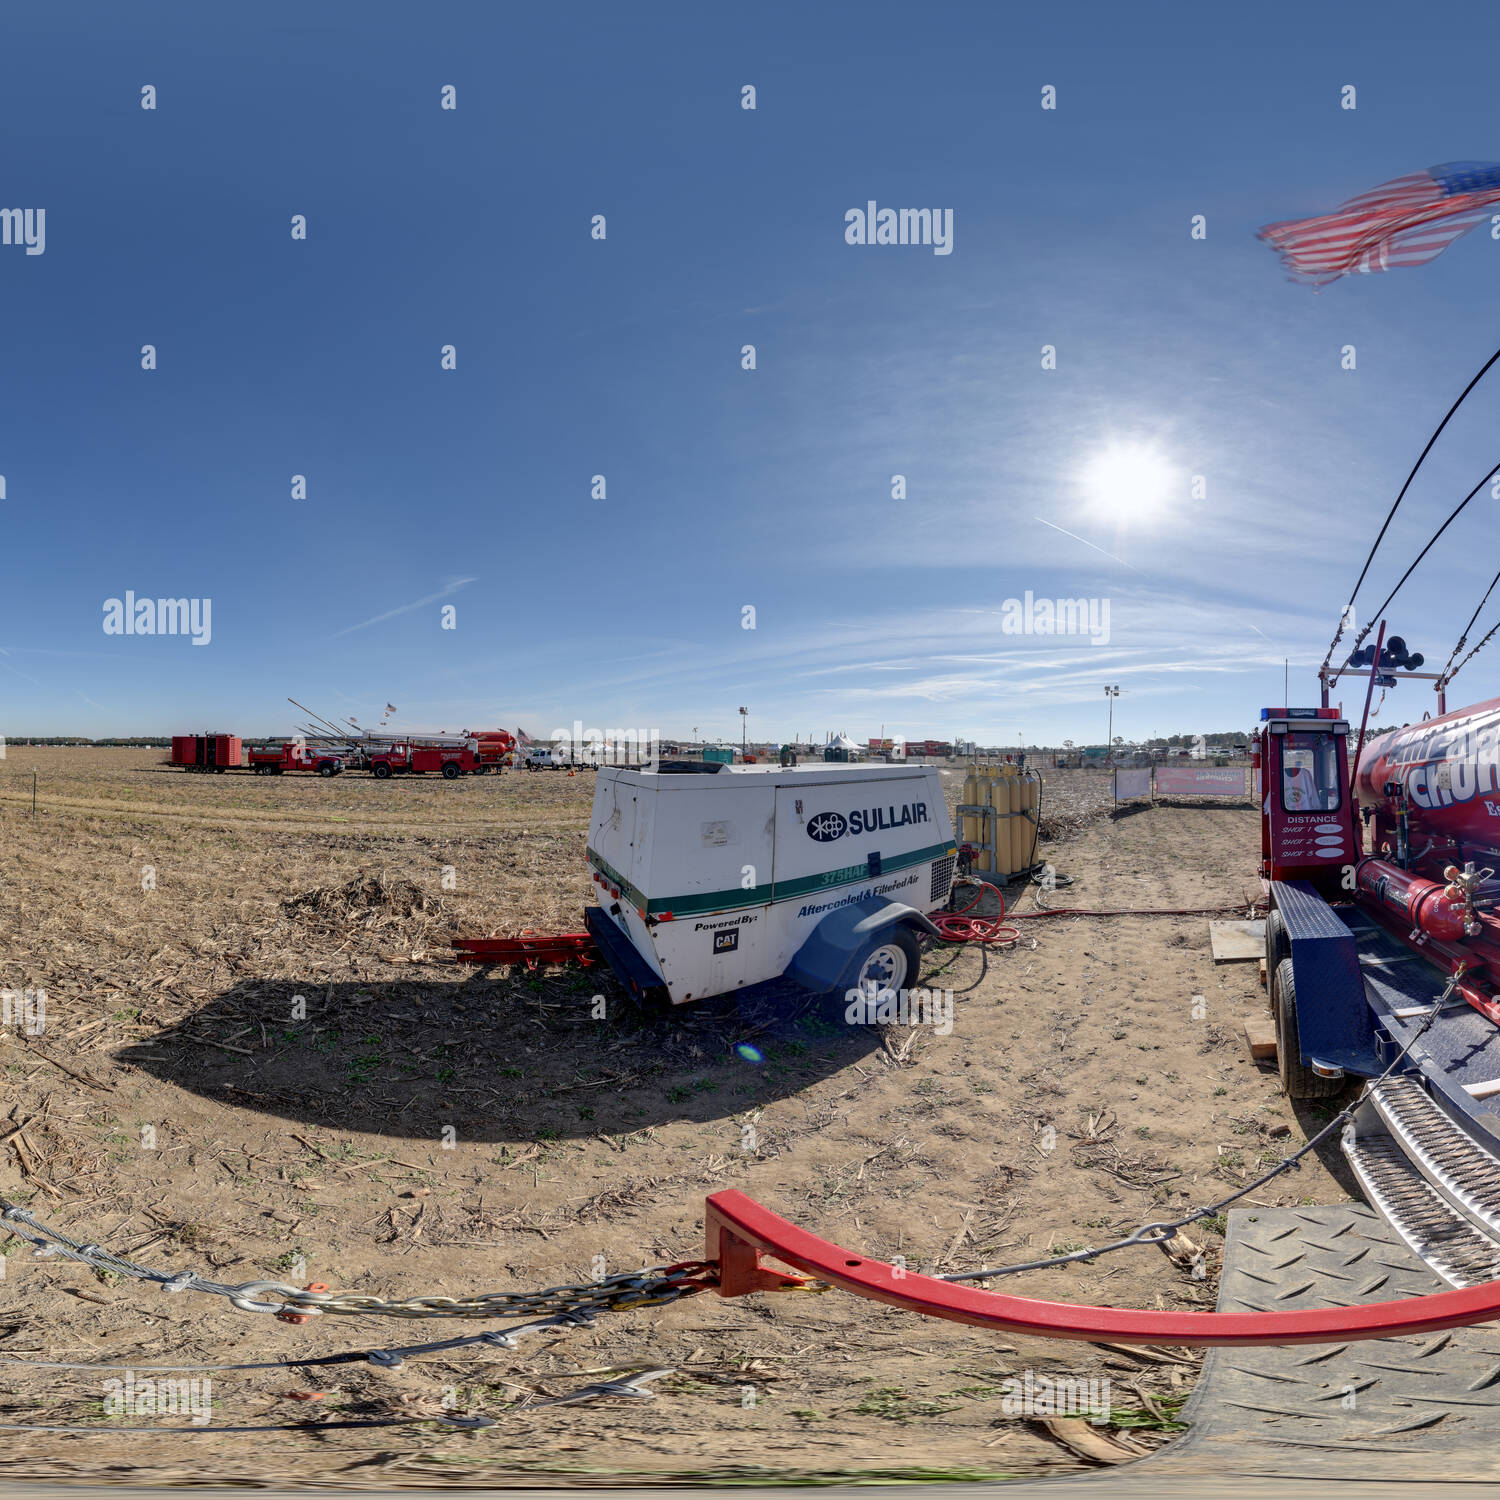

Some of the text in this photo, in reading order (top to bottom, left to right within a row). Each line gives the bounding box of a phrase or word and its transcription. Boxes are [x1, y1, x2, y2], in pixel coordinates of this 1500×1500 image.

[849, 802, 927, 835] SULLAIR
[1287, 815, 1337, 824] DISTANCE
[798, 875, 919, 918] Aftercooled & Filtered Air
[694, 915, 758, 931] Powered By:
[716, 934, 737, 948] CAT
